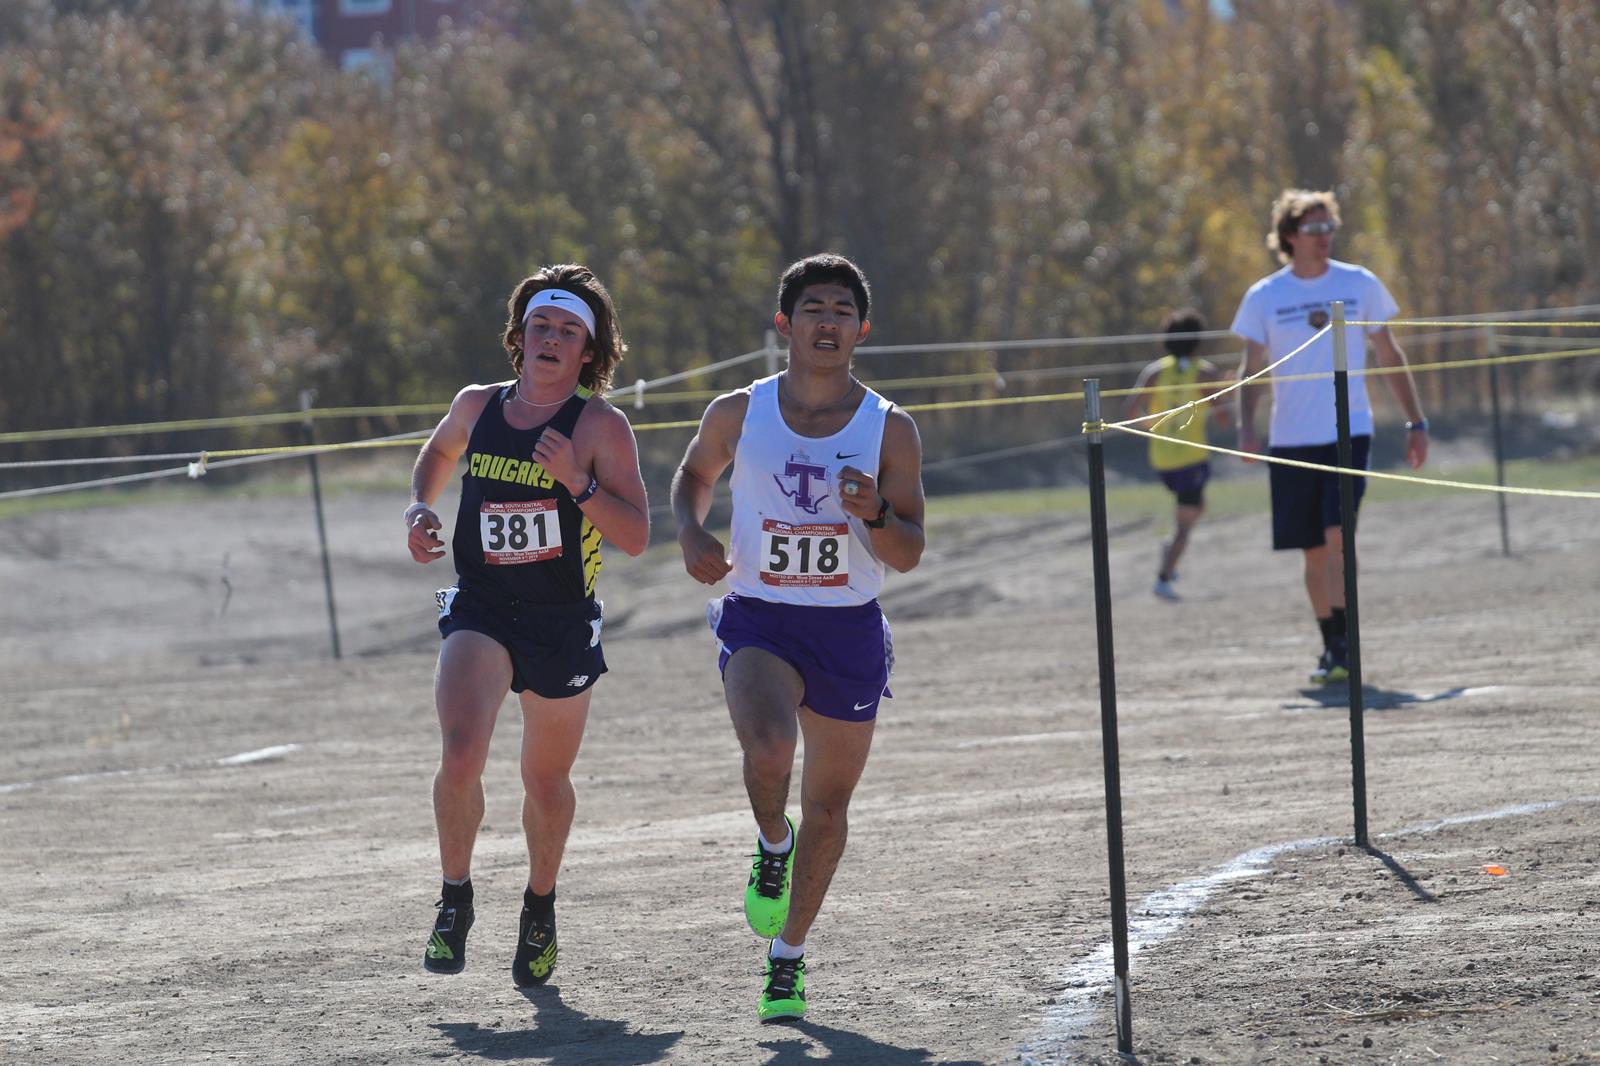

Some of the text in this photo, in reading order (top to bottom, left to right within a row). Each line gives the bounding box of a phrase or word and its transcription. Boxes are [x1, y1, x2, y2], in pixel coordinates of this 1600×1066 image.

[470, 452, 556, 490] COUGARS
[487, 513, 548, 551] 381
[768, 527, 793, 535] REGIONAL
[768, 534, 839, 574] 518
